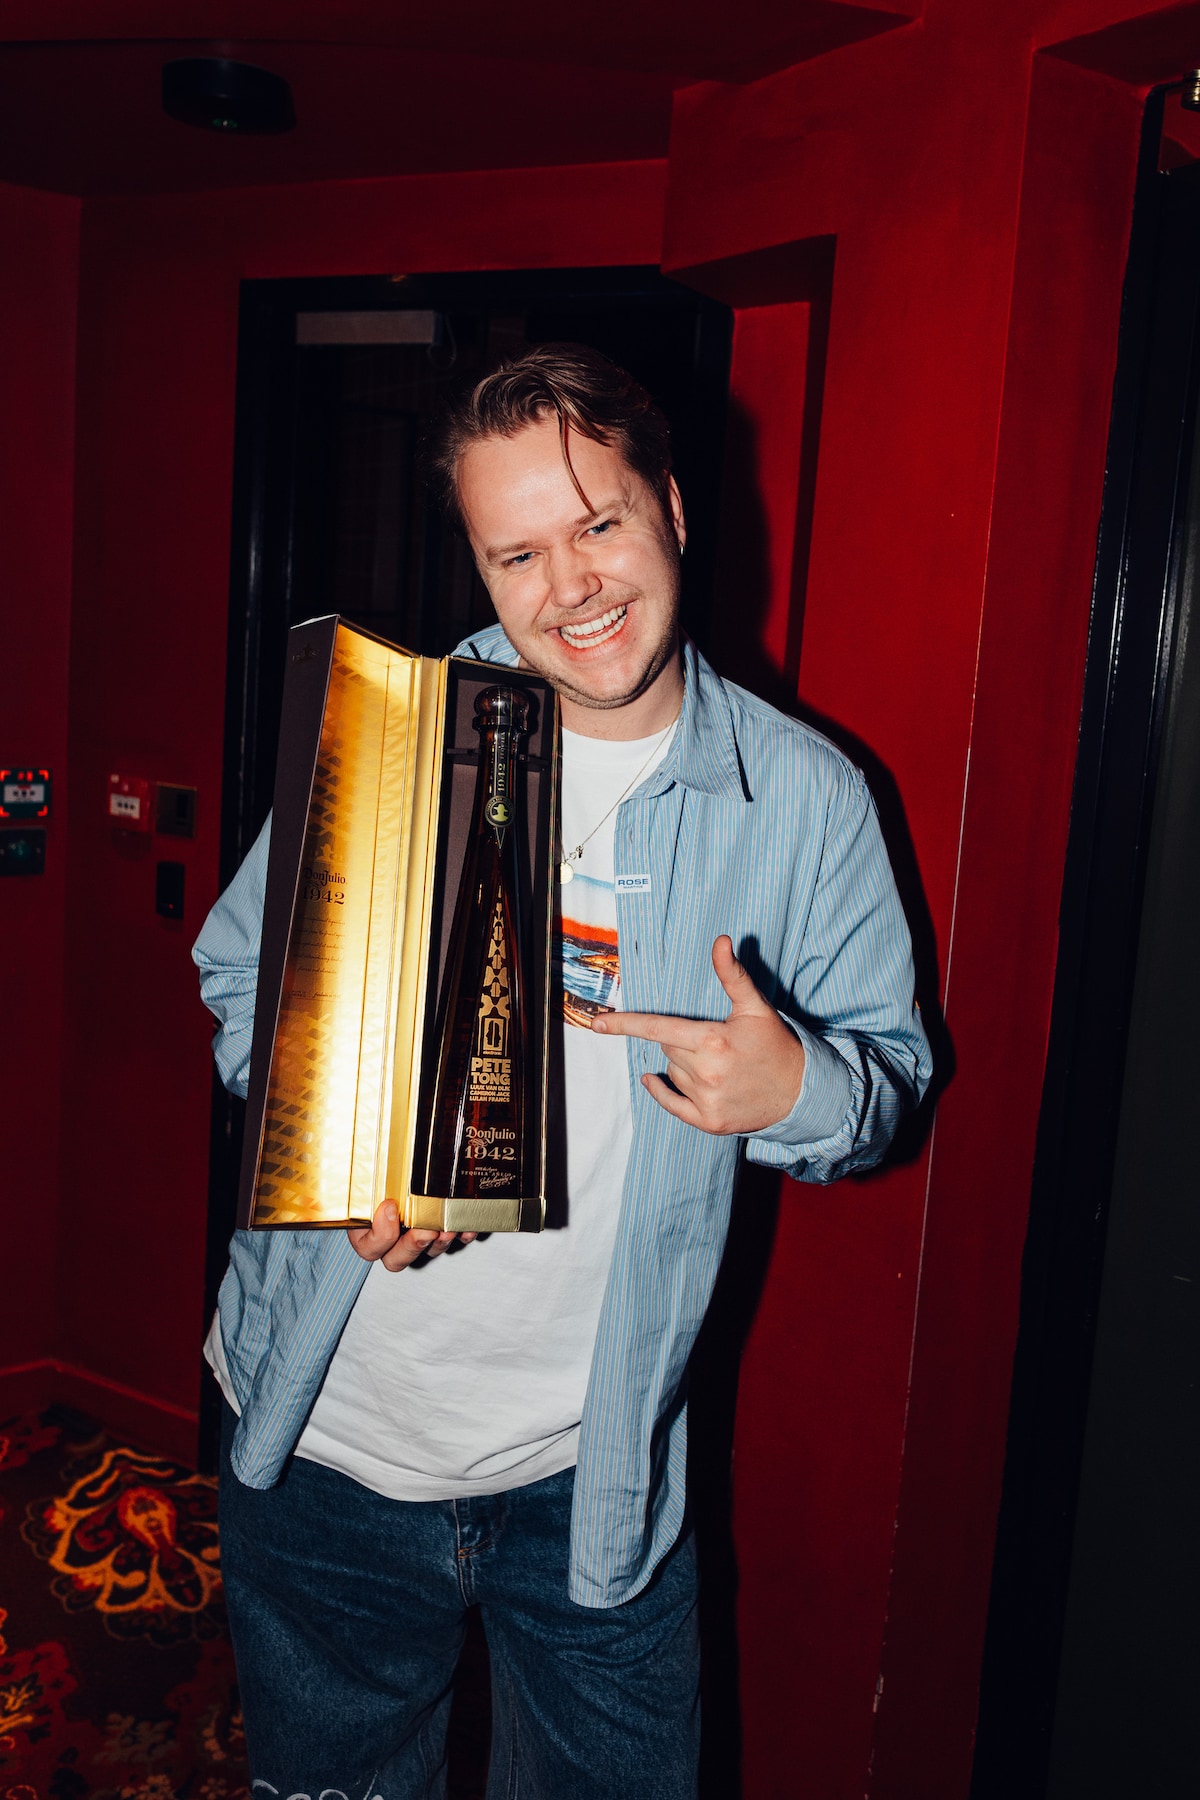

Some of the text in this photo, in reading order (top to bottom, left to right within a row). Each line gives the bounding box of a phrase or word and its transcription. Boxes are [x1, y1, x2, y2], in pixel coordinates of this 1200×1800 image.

[617, 878, 649, 886] ROSE
[303, 887, 345, 905] 1942
[471, 1057, 511, 1073] PETE
[471, 1072, 511, 1086] TONG
